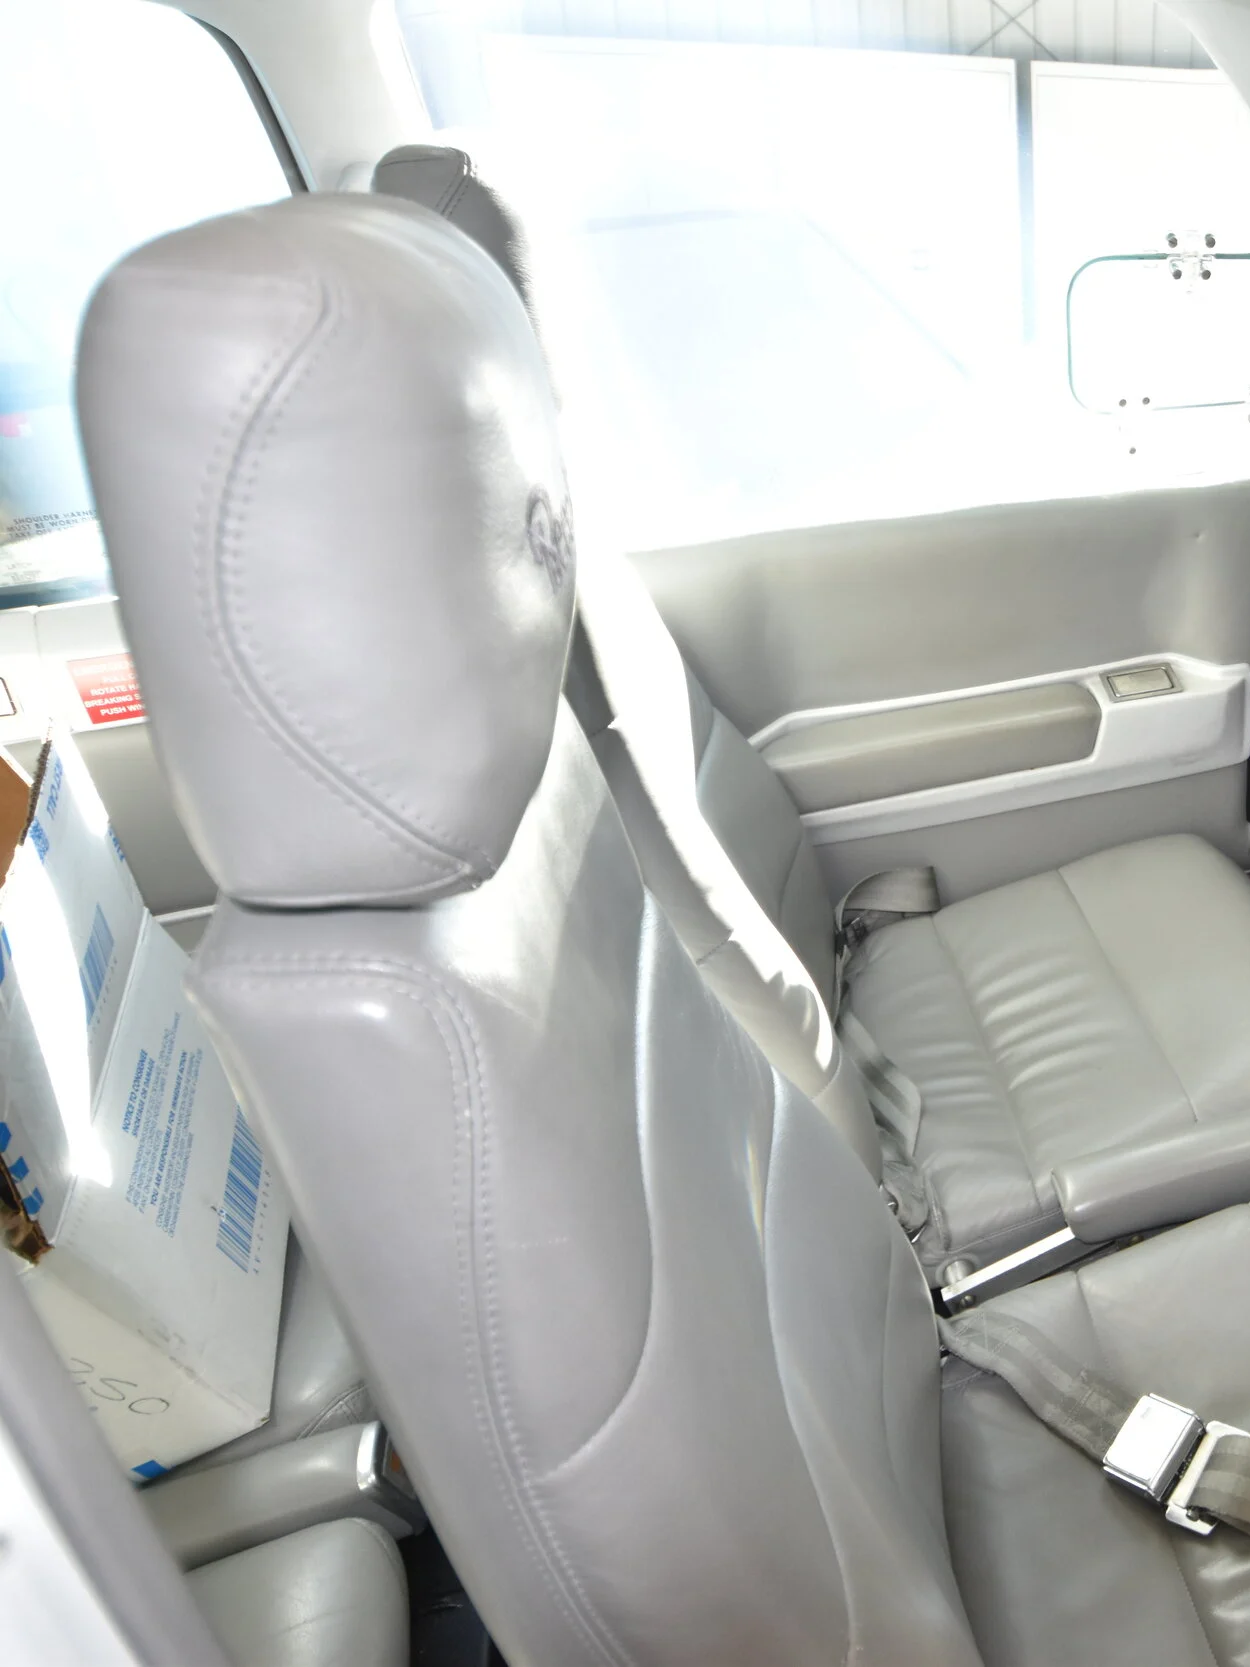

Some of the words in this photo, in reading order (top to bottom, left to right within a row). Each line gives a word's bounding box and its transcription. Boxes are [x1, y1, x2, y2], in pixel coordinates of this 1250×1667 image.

[90, 684, 128, 696] ROTATE
[84, 694, 133, 708] BREAKING
[100, 705, 126, 716] PUSH
[132, 1048, 148, 1093] CONSIGNEE
[178, 1050, 188, 1074] ACTION
[129, 1091, 137, 1102] TO
[132, 1099, 145, 1138] SHORTAGE
[140, 1088, 148, 1100] OR
[144, 1057, 156, 1088] DAMAGE
[172, 1074, 182, 1110] IMMEDIATE
[122, 1102, 135, 1134] NOTICE
[168, 1110, 176, 1125] FOR
[158, 1126, 172, 1172] RESPONSIBLE
[154, 1172, 162, 1188] ARE
[150, 1188, 159, 1206] YOU
